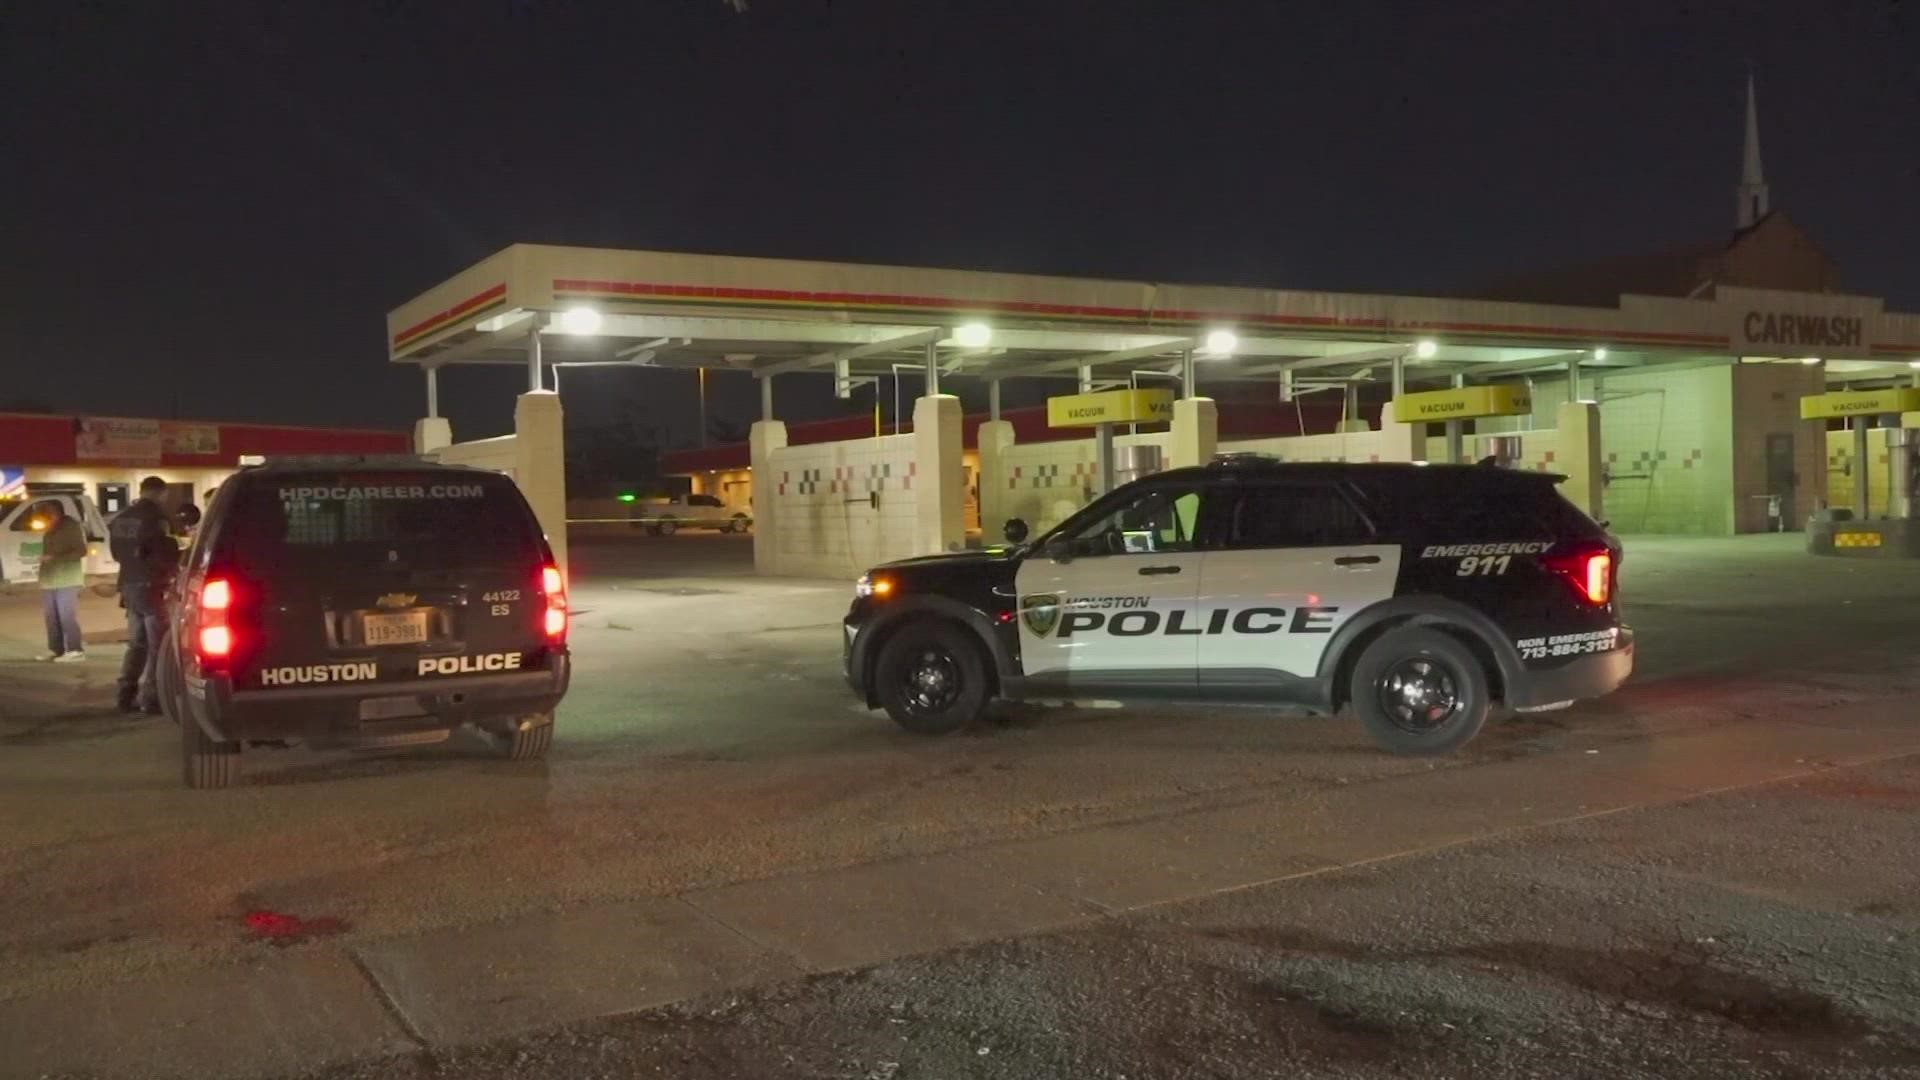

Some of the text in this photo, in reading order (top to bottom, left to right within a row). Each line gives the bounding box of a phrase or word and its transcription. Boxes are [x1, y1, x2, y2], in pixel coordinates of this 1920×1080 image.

[1744, 311, 1862, 346] CARWASH
[1068, 407, 1105, 419] VACUUM
[1420, 402, 1465, 414] VACUUM
[1832, 401, 1879, 412] VACUUM
[279, 485, 484, 501] HPDCAREER.COM
[1421, 542, 1556, 558] EMERGENCY
[1455, 556, 1512, 576] 911
[482, 590, 521, 602] 44122
[1064, 596, 1150, 609] HOUSTON
[491, 604, 510, 616] ES
[1056, 606, 1338, 637] POLICE
[1517, 637, 1546, 649] NON
[1521, 638, 1616, 660] 713-884-3131
[418, 652, 522, 676] POLICE
[261, 663, 378, 686] HOUSTON
